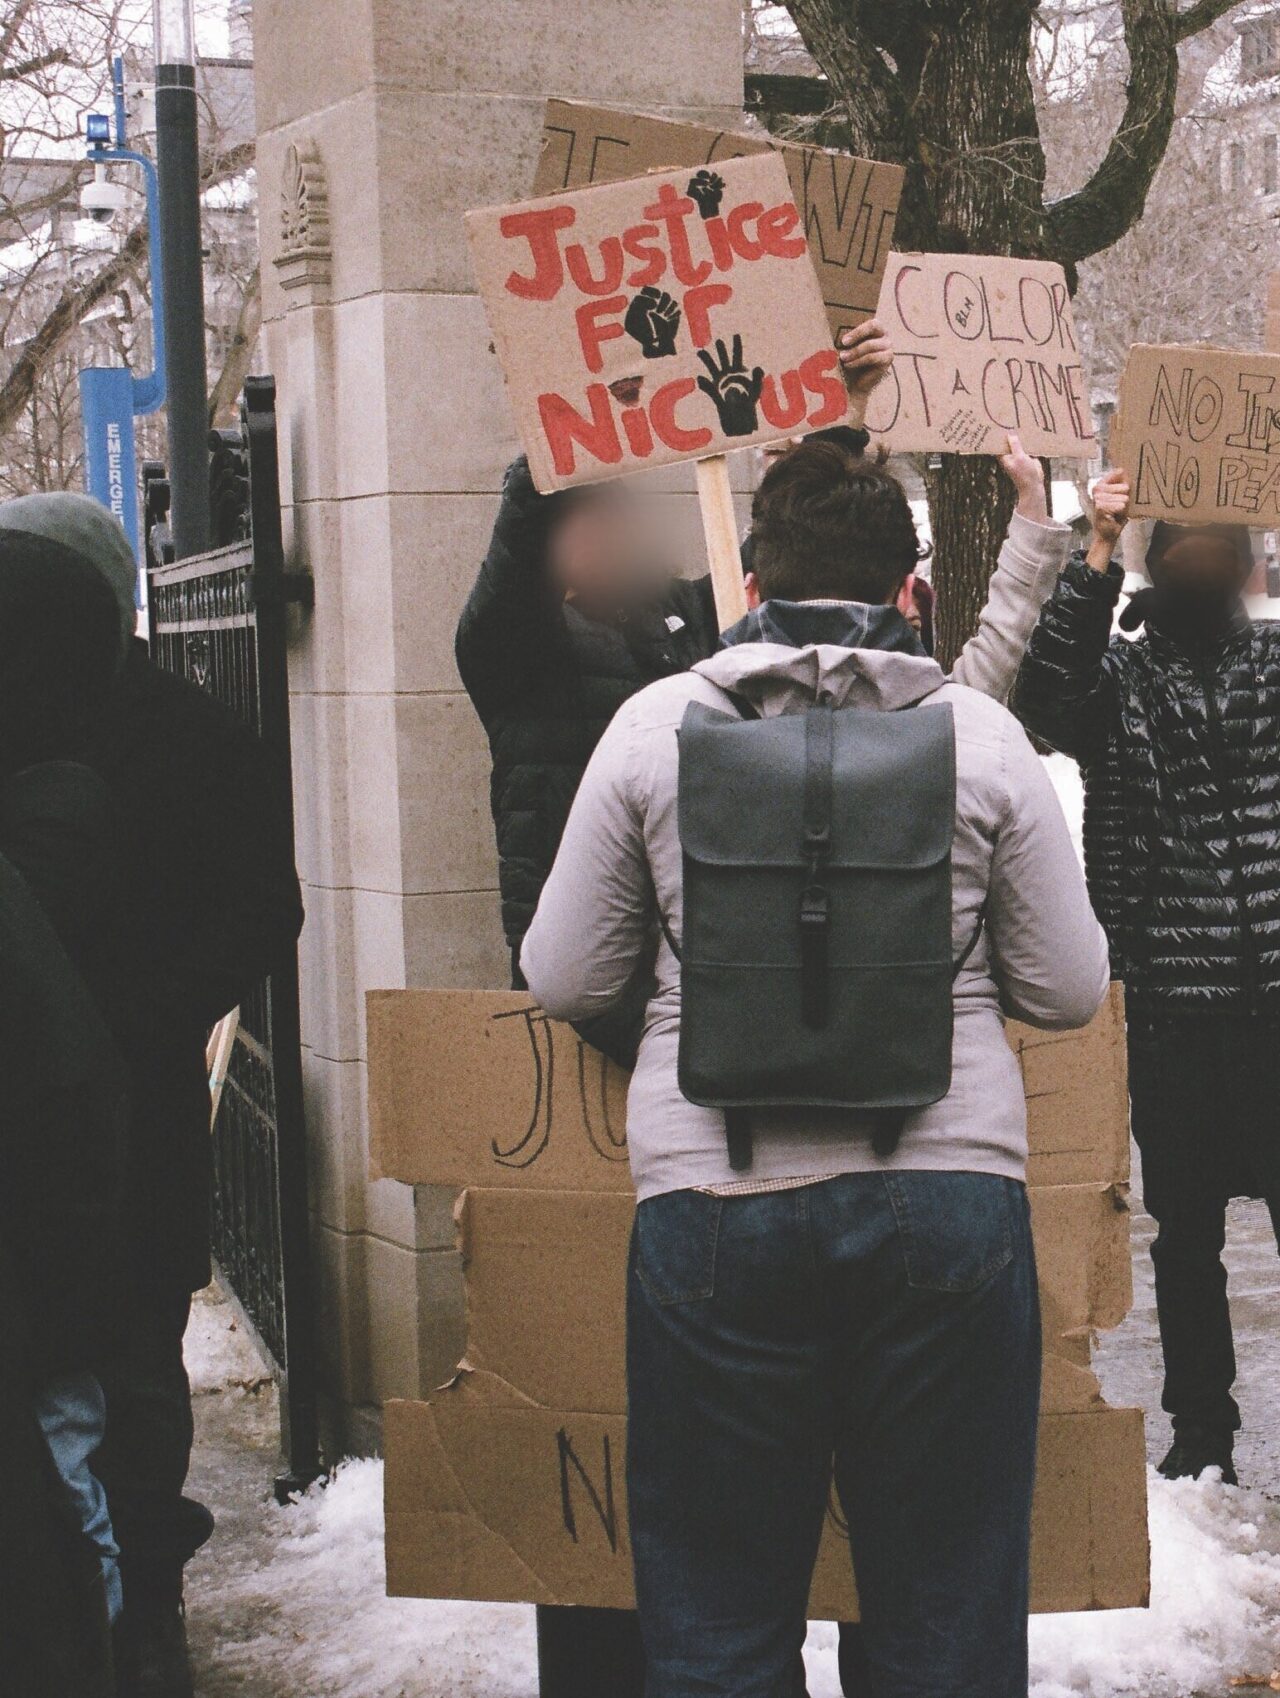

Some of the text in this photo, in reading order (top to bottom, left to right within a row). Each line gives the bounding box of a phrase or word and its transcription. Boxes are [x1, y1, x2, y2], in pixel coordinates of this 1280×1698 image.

[500, 183, 806, 300] Justice
[895, 265, 1076, 351] COLOR
[955, 296, 975, 328] BLM
[536, 348, 849, 476] Nicus
[951, 368, 971, 395] A
[981, 357, 1095, 440] CRIME
[1149, 363, 1224, 443] NO
[107, 423, 125, 527] EMERGE
